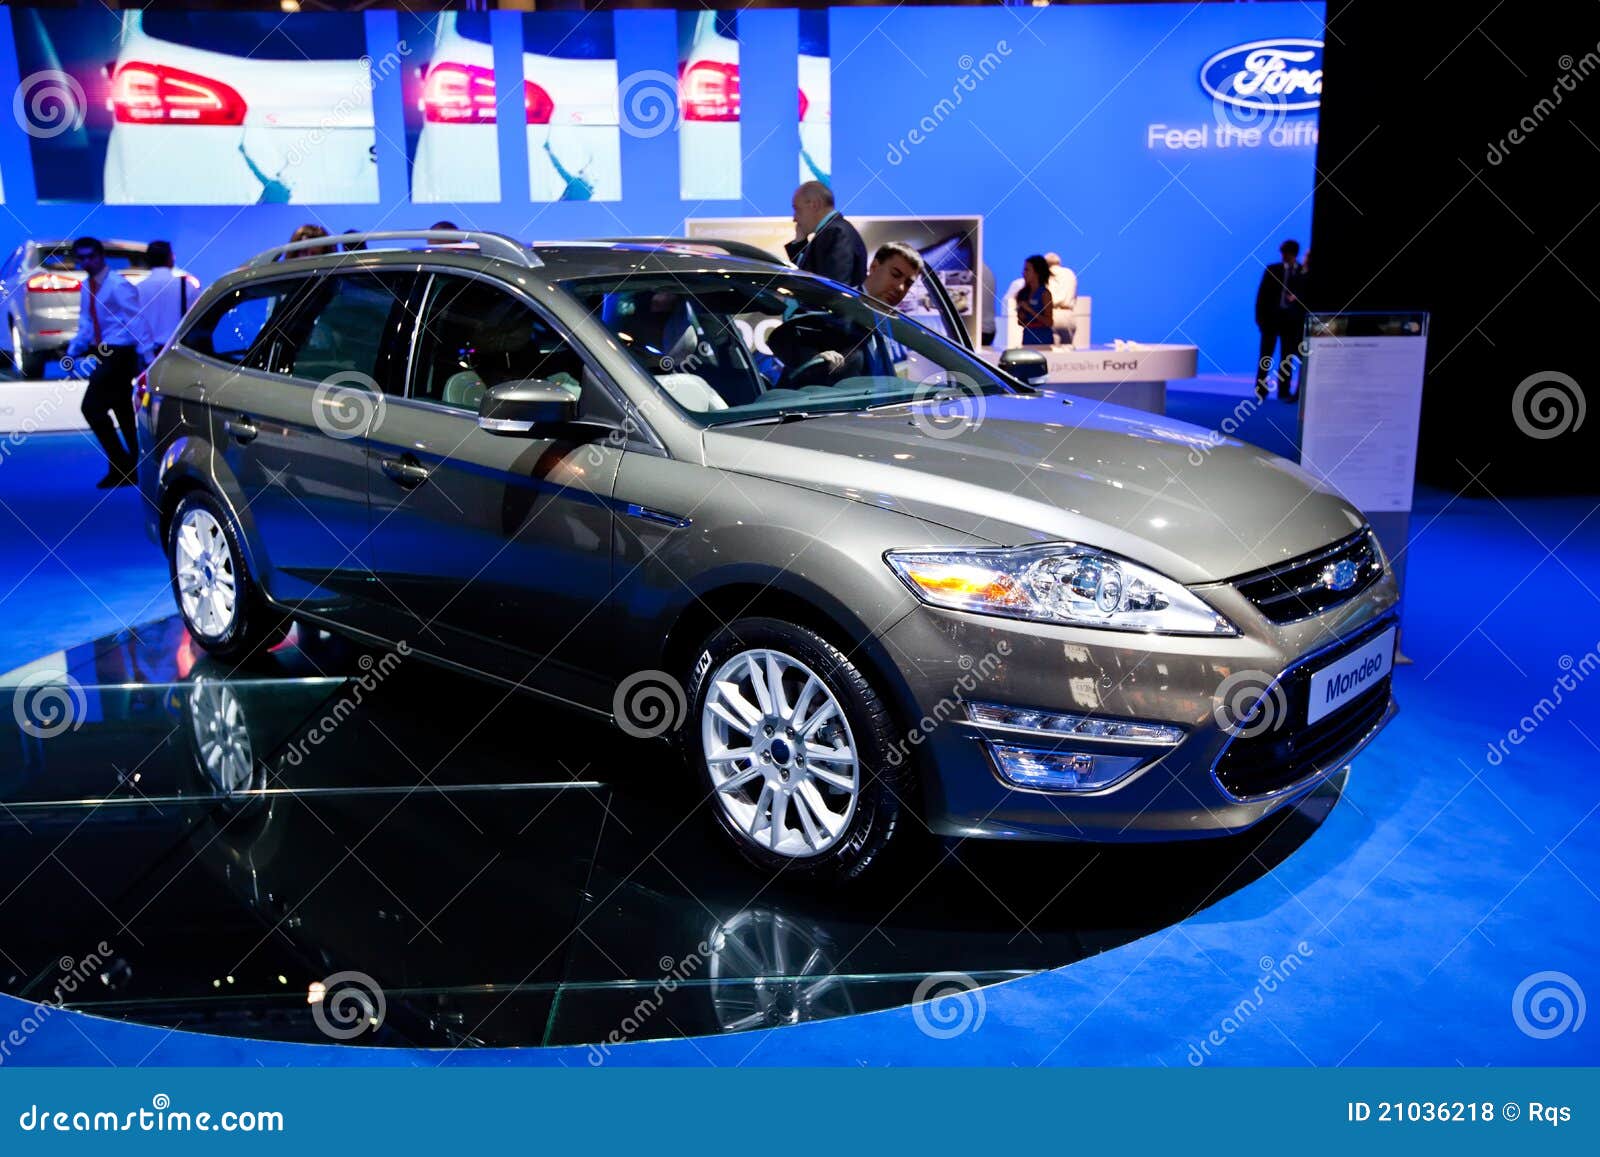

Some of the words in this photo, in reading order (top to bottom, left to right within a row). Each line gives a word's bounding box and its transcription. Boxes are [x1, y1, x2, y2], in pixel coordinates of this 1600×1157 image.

[1147, 123, 1208, 149] Feel
[1215, 122, 1262, 148] the
[1102, 359, 1139, 371] Ford
[1325, 652, 1383, 704] Mondeo
